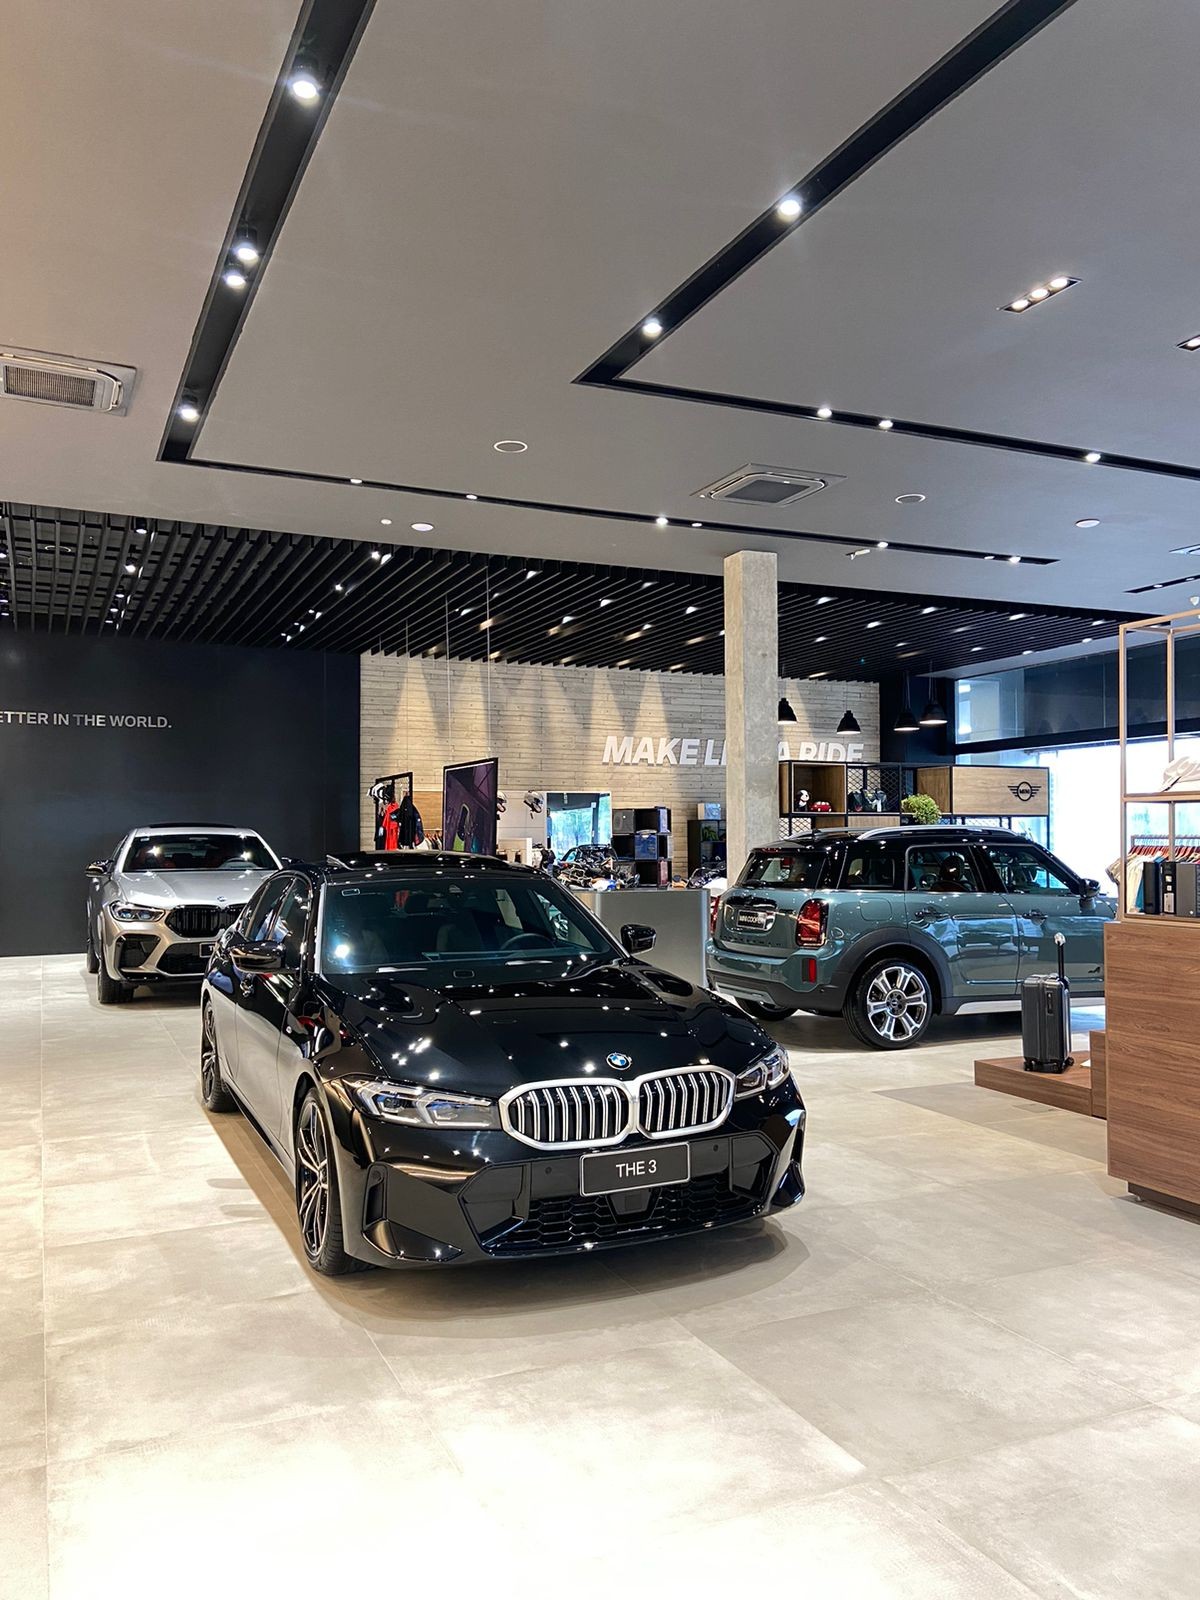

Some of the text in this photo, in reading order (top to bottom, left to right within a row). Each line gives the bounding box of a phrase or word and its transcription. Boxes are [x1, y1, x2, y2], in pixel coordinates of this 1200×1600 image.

[53, 713, 70, 726] IN
[73, 714, 107, 728] THE
[109, 715, 172, 729] WORLD.
[602, 736, 700, 766] MAKE
[799, 741, 868, 763] RIDE
[615, 1159, 657, 1178] THE 3
